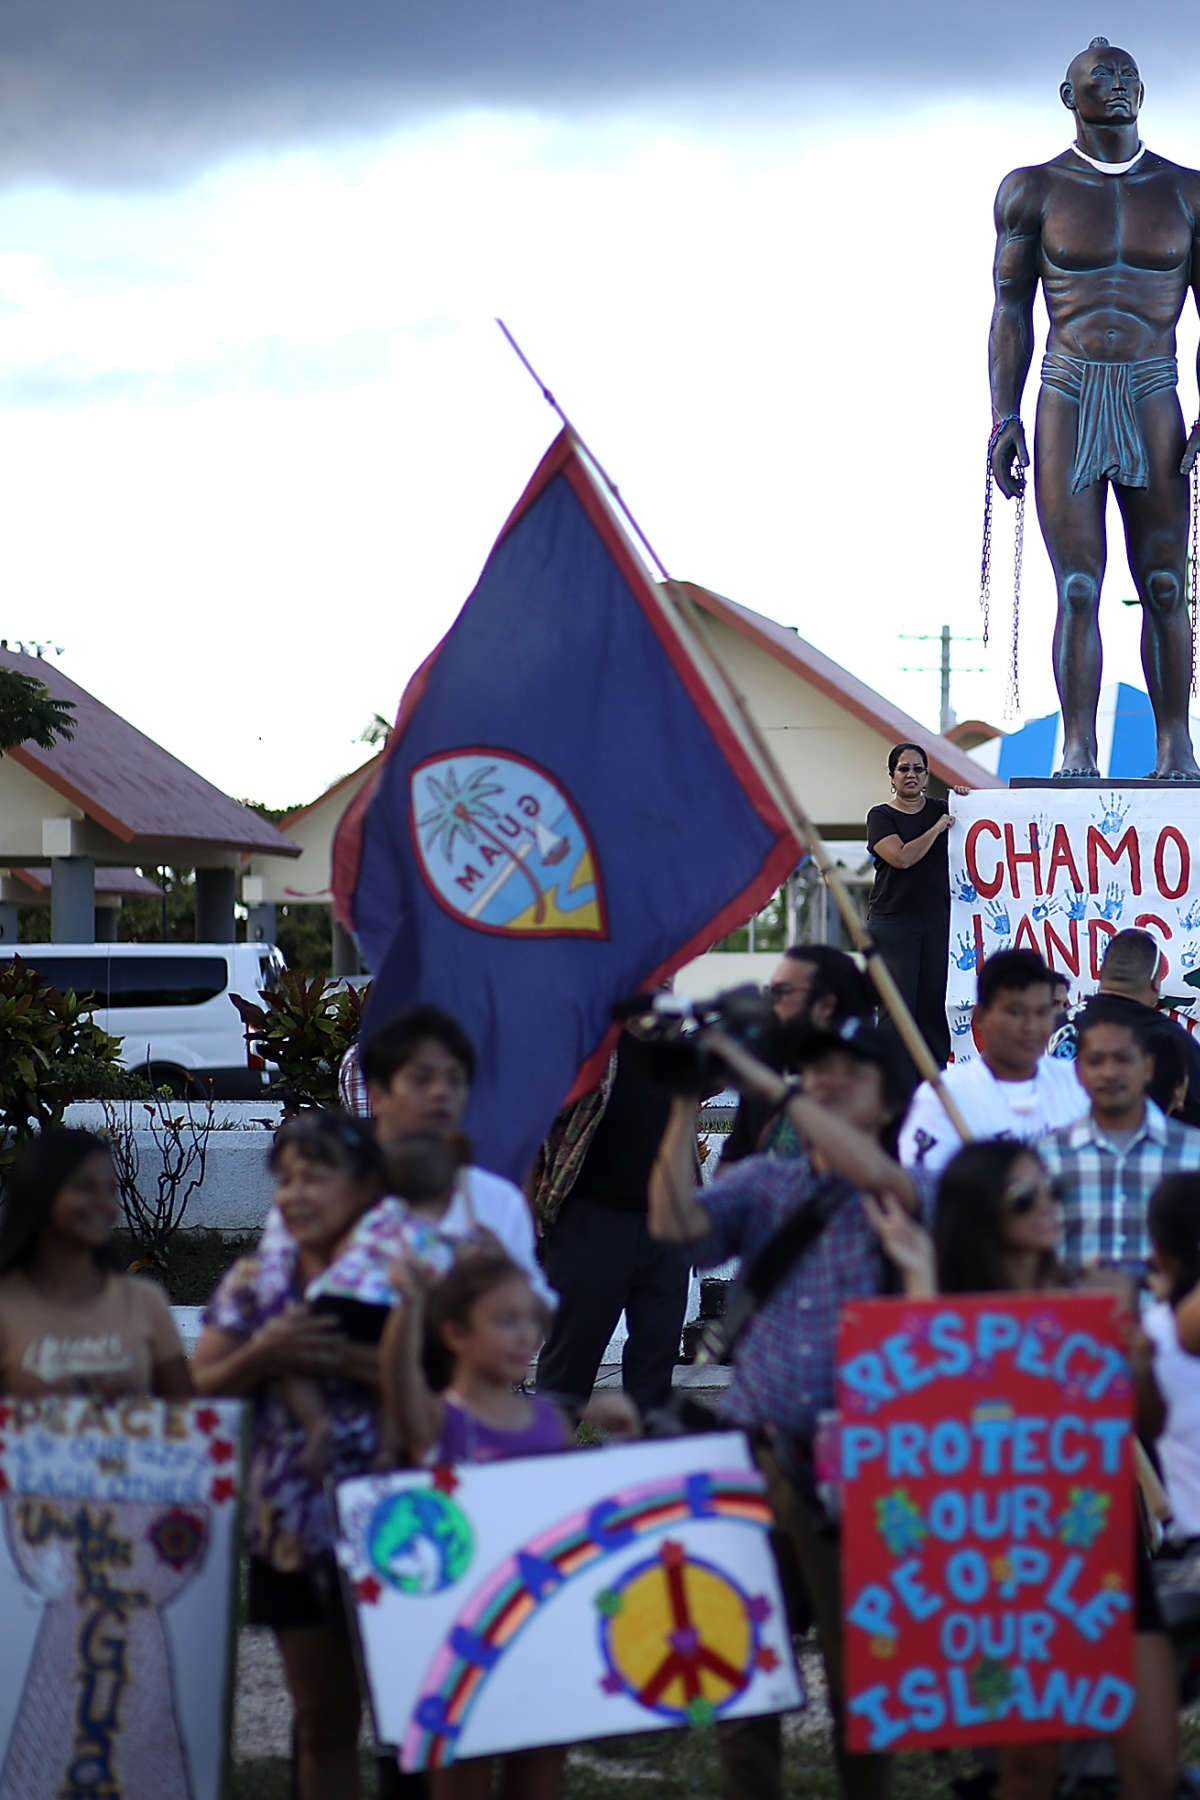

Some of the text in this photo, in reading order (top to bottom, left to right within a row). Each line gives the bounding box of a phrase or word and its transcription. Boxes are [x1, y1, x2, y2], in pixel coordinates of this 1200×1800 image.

[841, 1311, 1135, 1411] RESPECT
[841, 1415, 1131, 1479] PROTECT
[929, 1485, 1057, 1541] OUR
[848, 1544, 1133, 1642] PEOPLE
[940, 1612, 1057, 1661] OUR
[849, 1664, 1136, 1750] ISLAND
